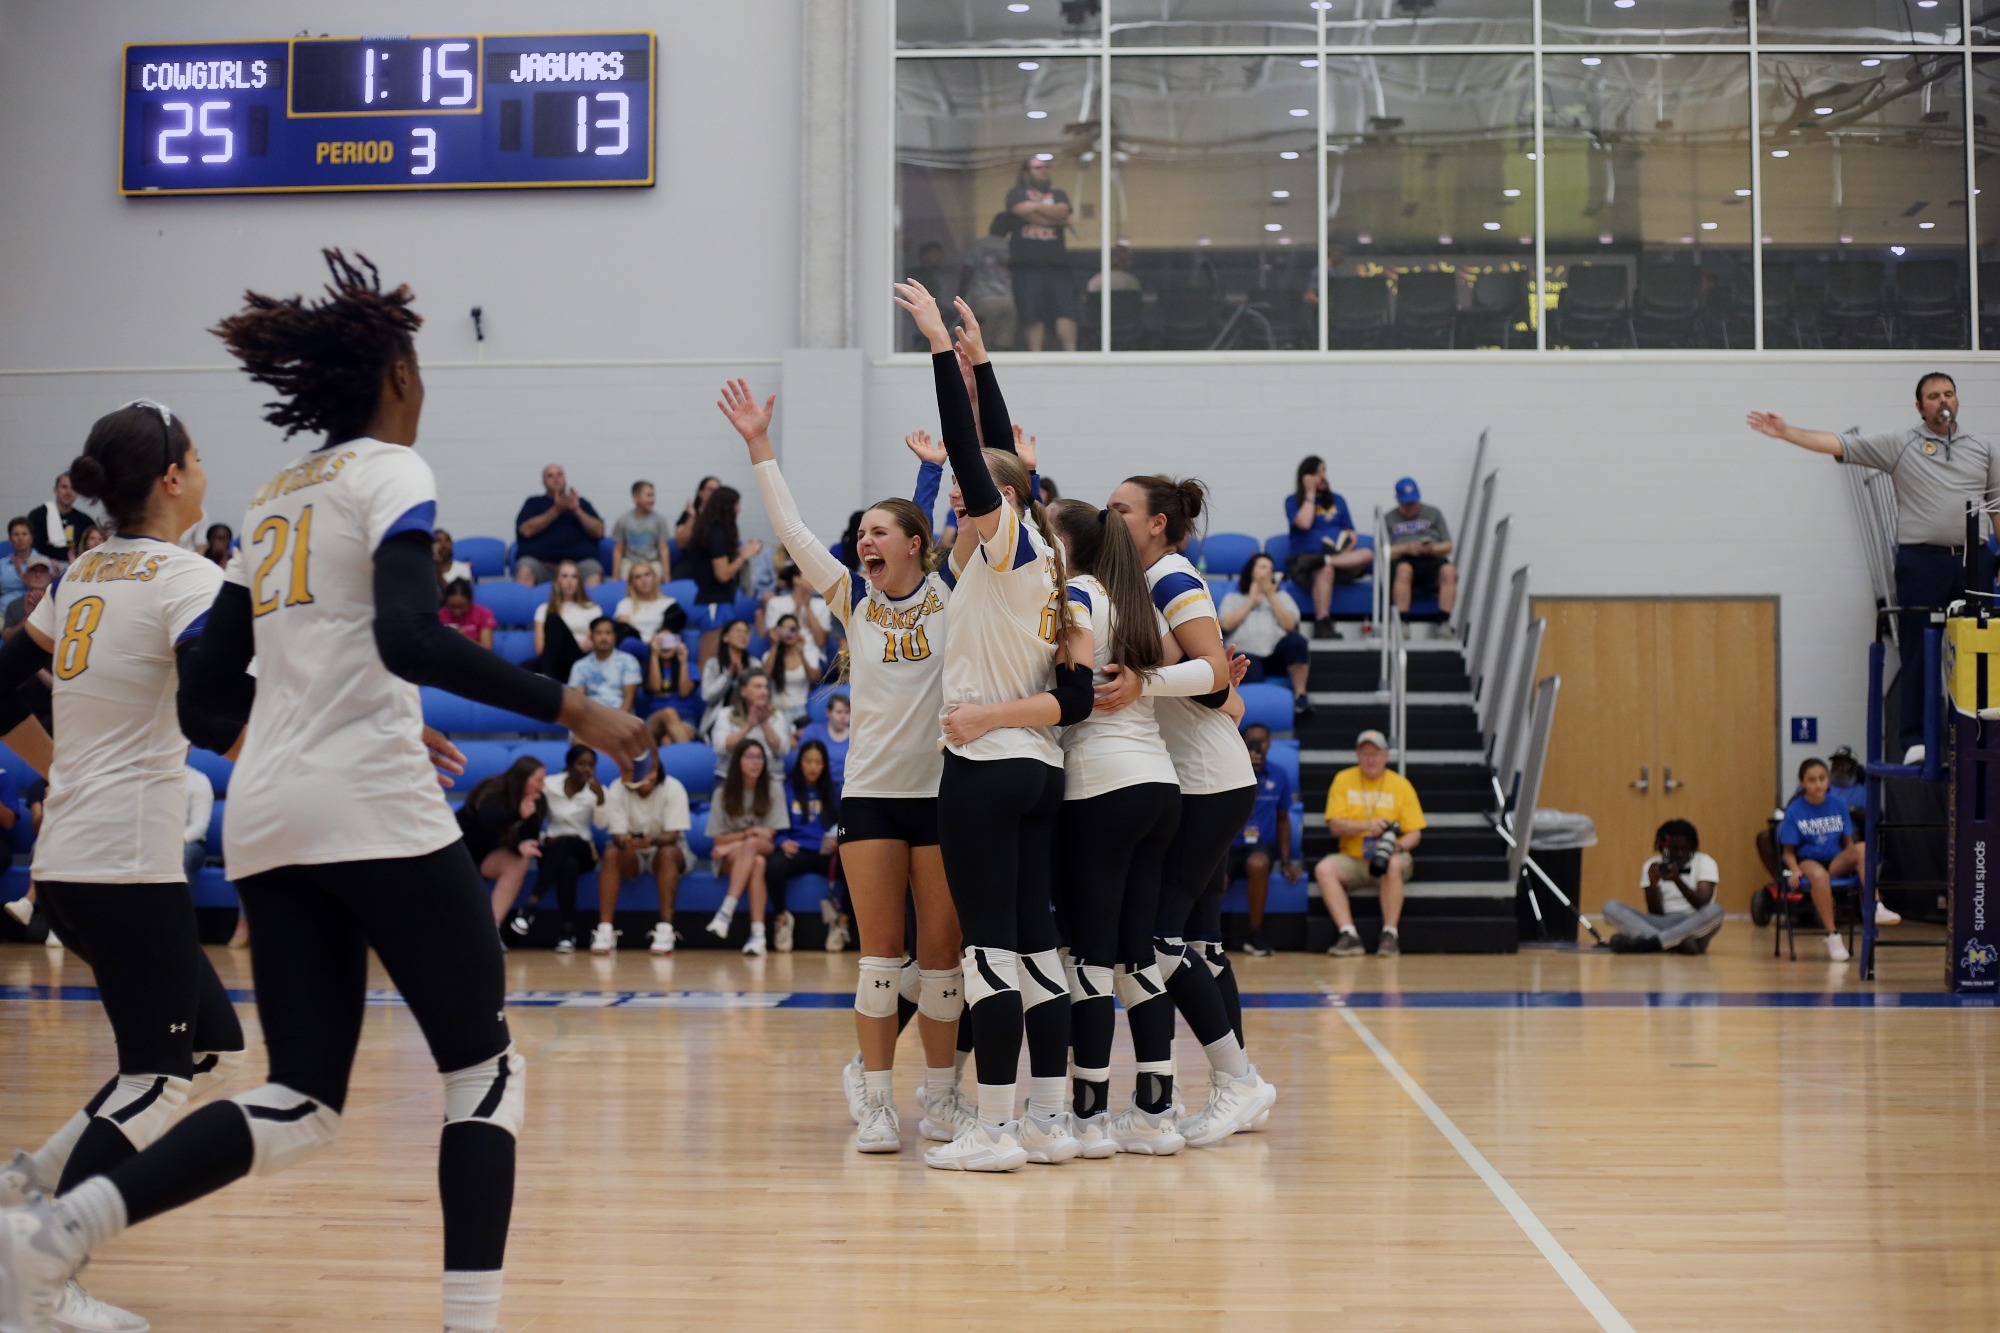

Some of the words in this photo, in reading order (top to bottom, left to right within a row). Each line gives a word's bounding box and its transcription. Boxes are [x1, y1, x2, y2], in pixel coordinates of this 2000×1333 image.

[142, 60, 268, 92] COWGIRLS
[510, 51, 625, 83] JAGUARS
[158, 101, 234, 164] 25
[576, 92, 630, 156] 13
[316, 140, 395, 165] PERIOD
[411, 127, 437, 175] 3
[252, 503, 316, 618] 21
[55, 595, 105, 681] 8
[882, 624, 932, 662] 10
[1973, 841, 1988, 881] sports
[1972, 882, 1987, 931] imports
